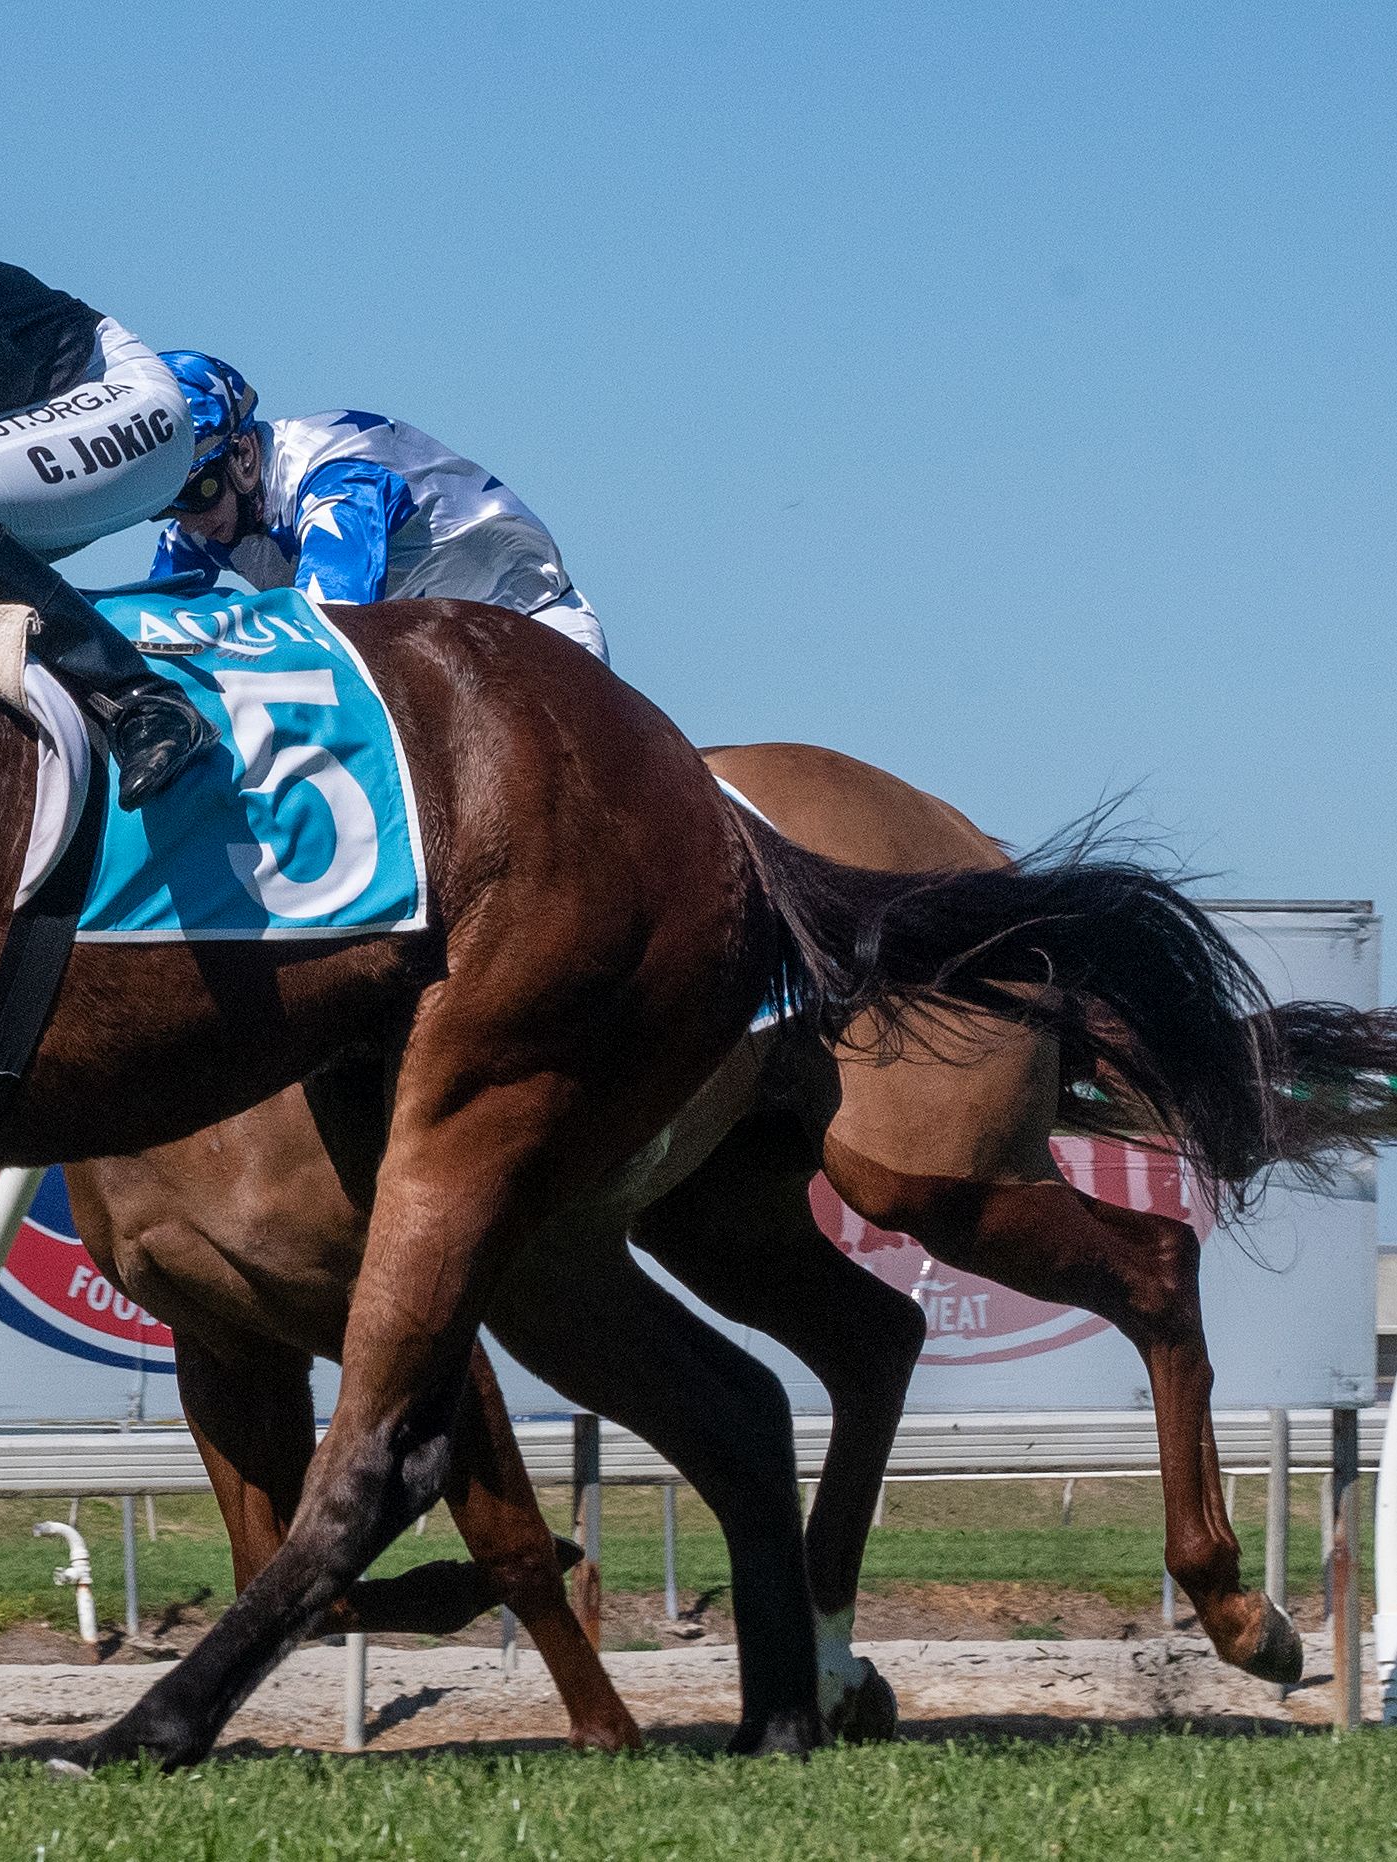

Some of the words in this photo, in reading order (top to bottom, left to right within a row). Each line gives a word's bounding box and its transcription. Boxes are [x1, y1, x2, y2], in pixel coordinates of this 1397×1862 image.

[26, 445, 77, 485] C.
[68, 407, 174, 476] Jokic
[213, 668, 379, 920] 5
